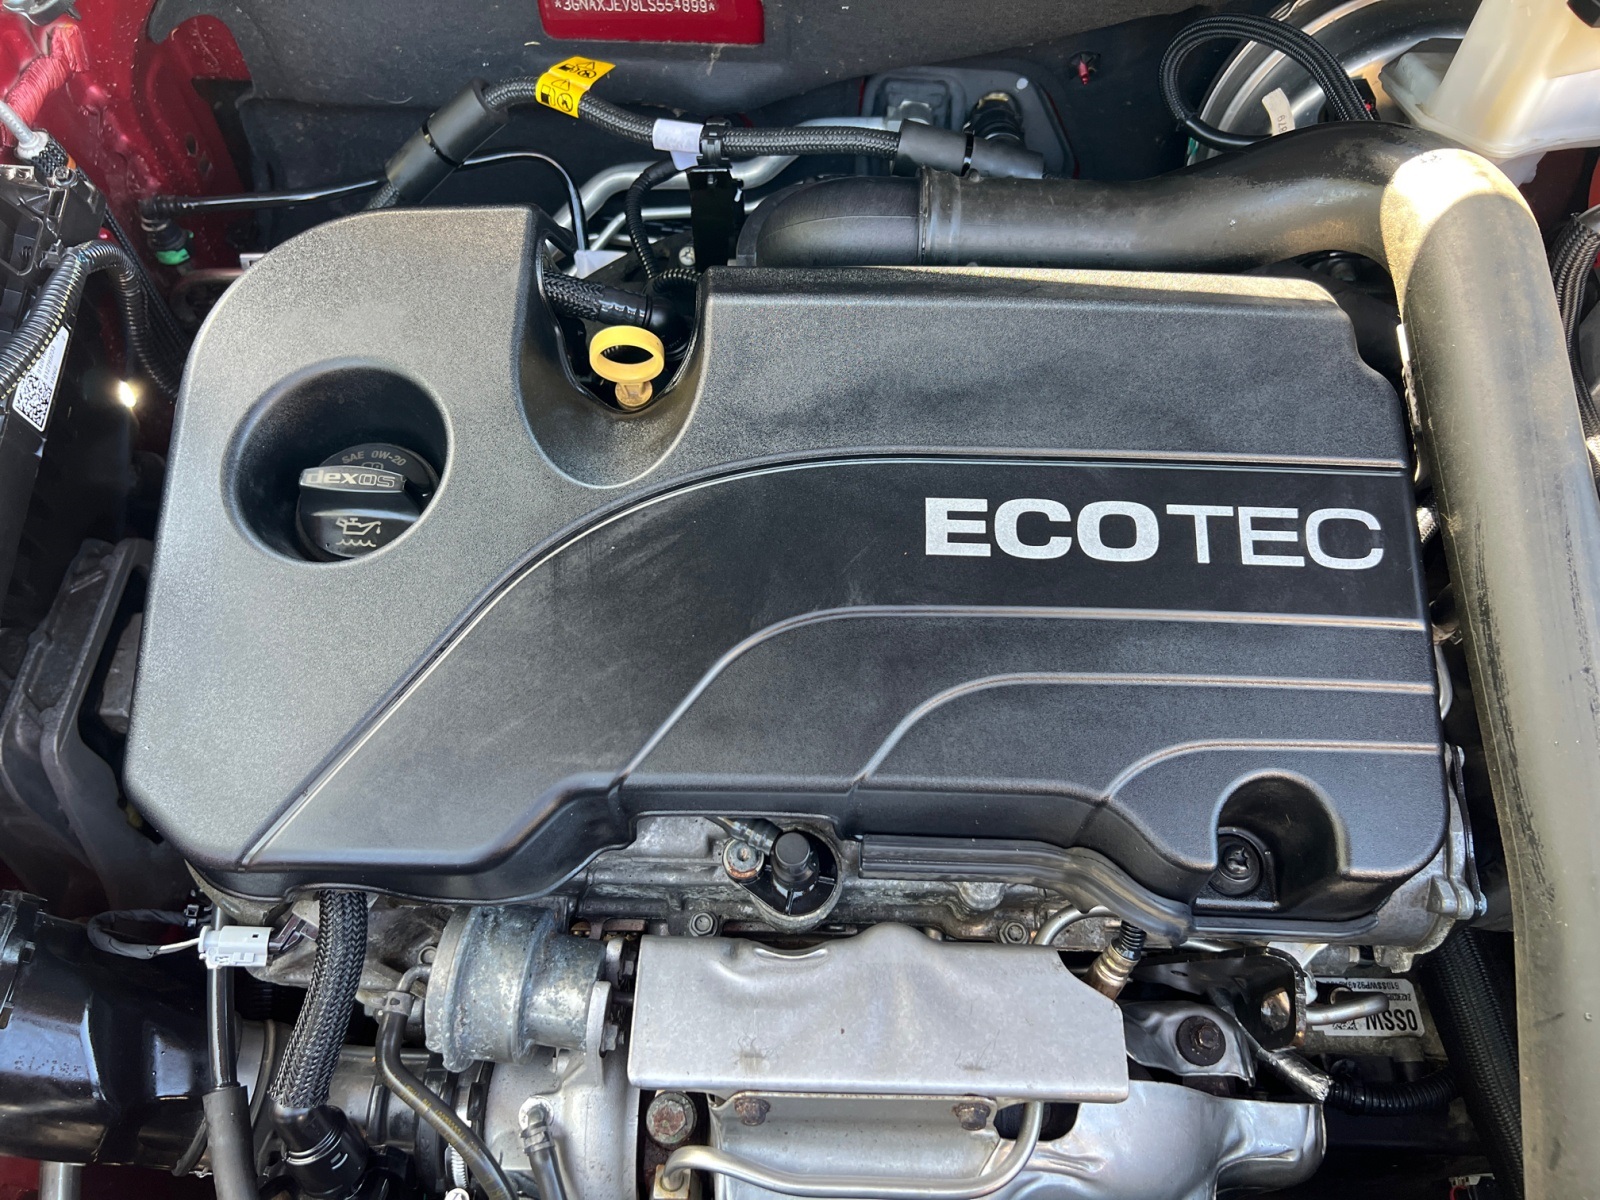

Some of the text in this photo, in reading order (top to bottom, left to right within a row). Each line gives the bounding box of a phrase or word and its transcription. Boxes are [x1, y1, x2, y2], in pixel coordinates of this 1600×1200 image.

[342, 450, 406, 466] SAE 0W-20
[305, 470, 396, 488] dexos
[925, 497, 1384, 570] ECOTEC
